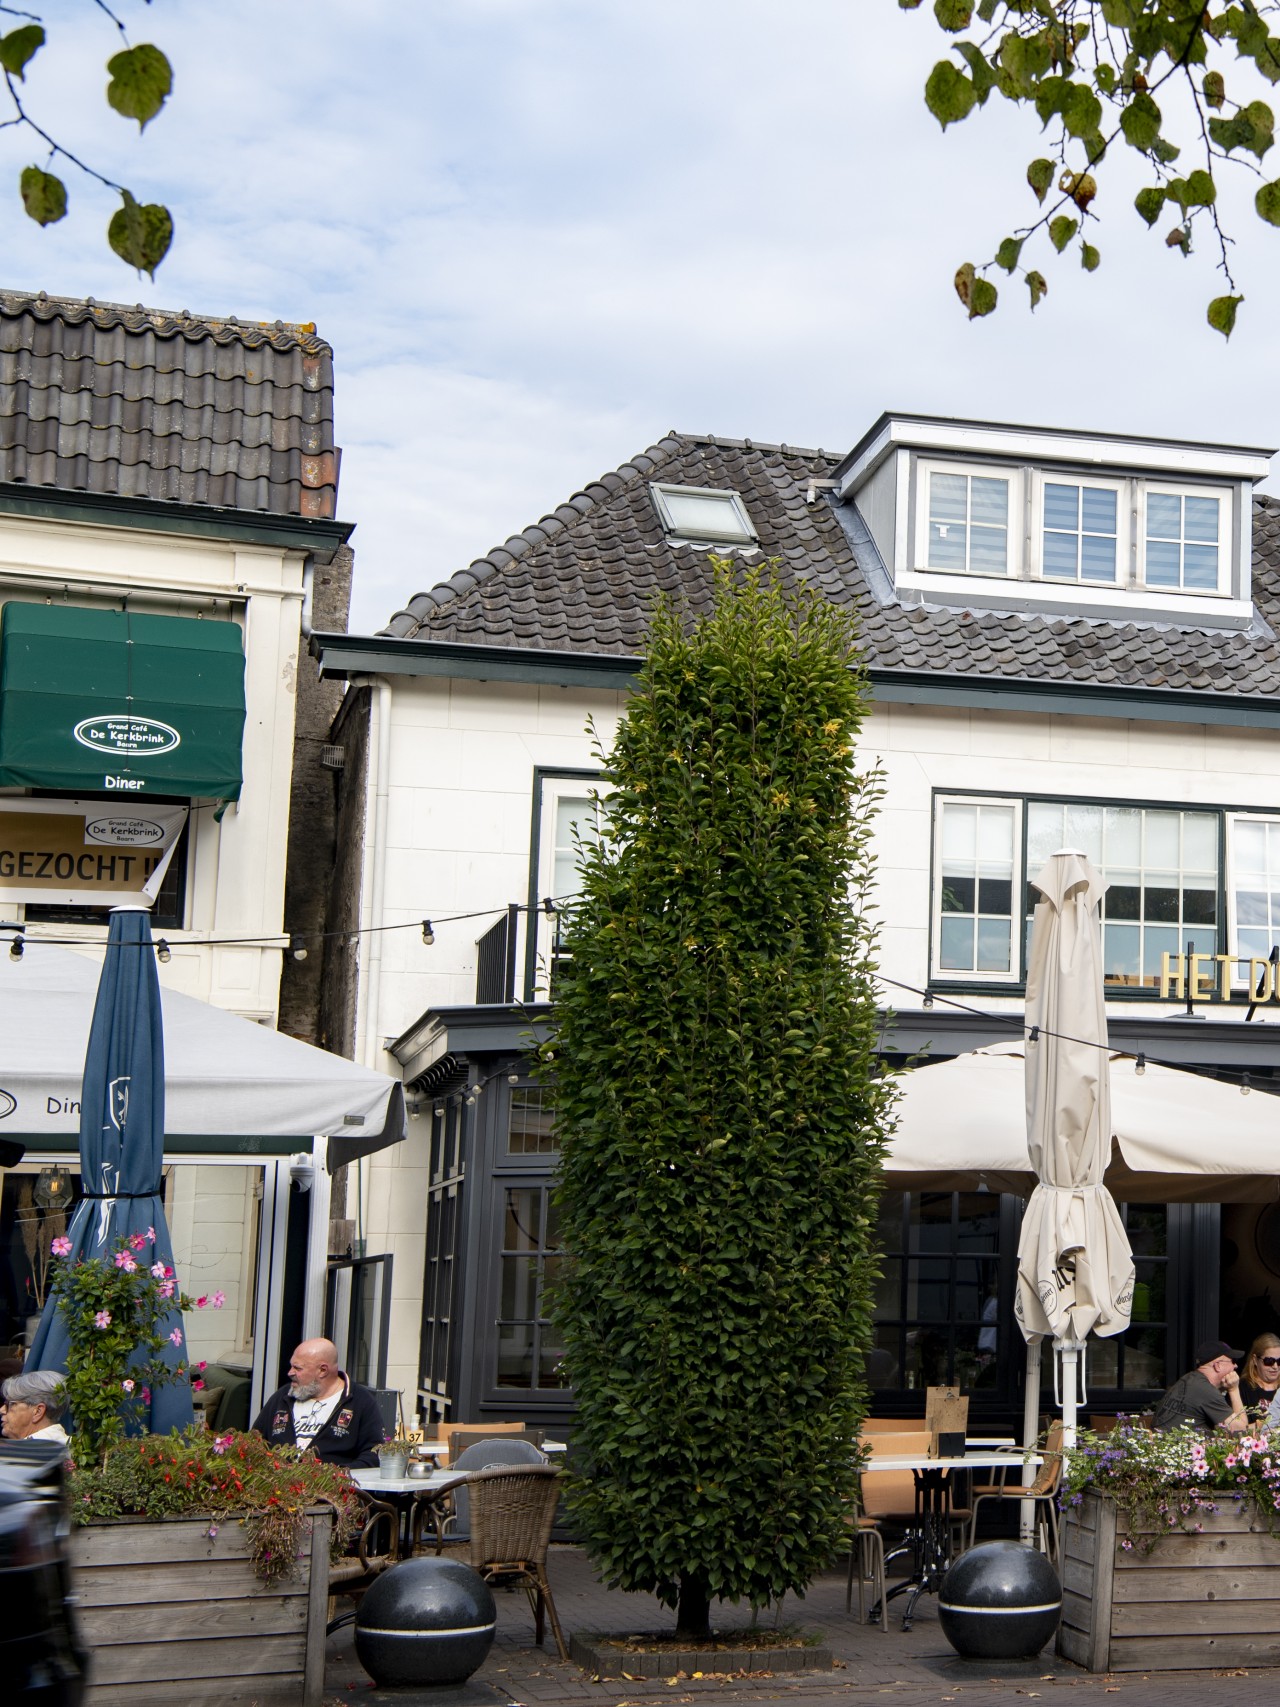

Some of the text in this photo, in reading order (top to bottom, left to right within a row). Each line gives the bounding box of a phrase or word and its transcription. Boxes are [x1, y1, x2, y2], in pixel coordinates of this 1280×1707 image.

[90, 729, 164, 743] De Kerkbrink
[104, 775, 145, 789] Diner
[93, 825, 159, 837] De Kerkbrink
[0, 850, 137, 882] GEZOCHT
[1160, 951, 1239, 1001] HET
[47, 1097, 81, 1114] Din
[408, 1433, 422, 1443] 37
